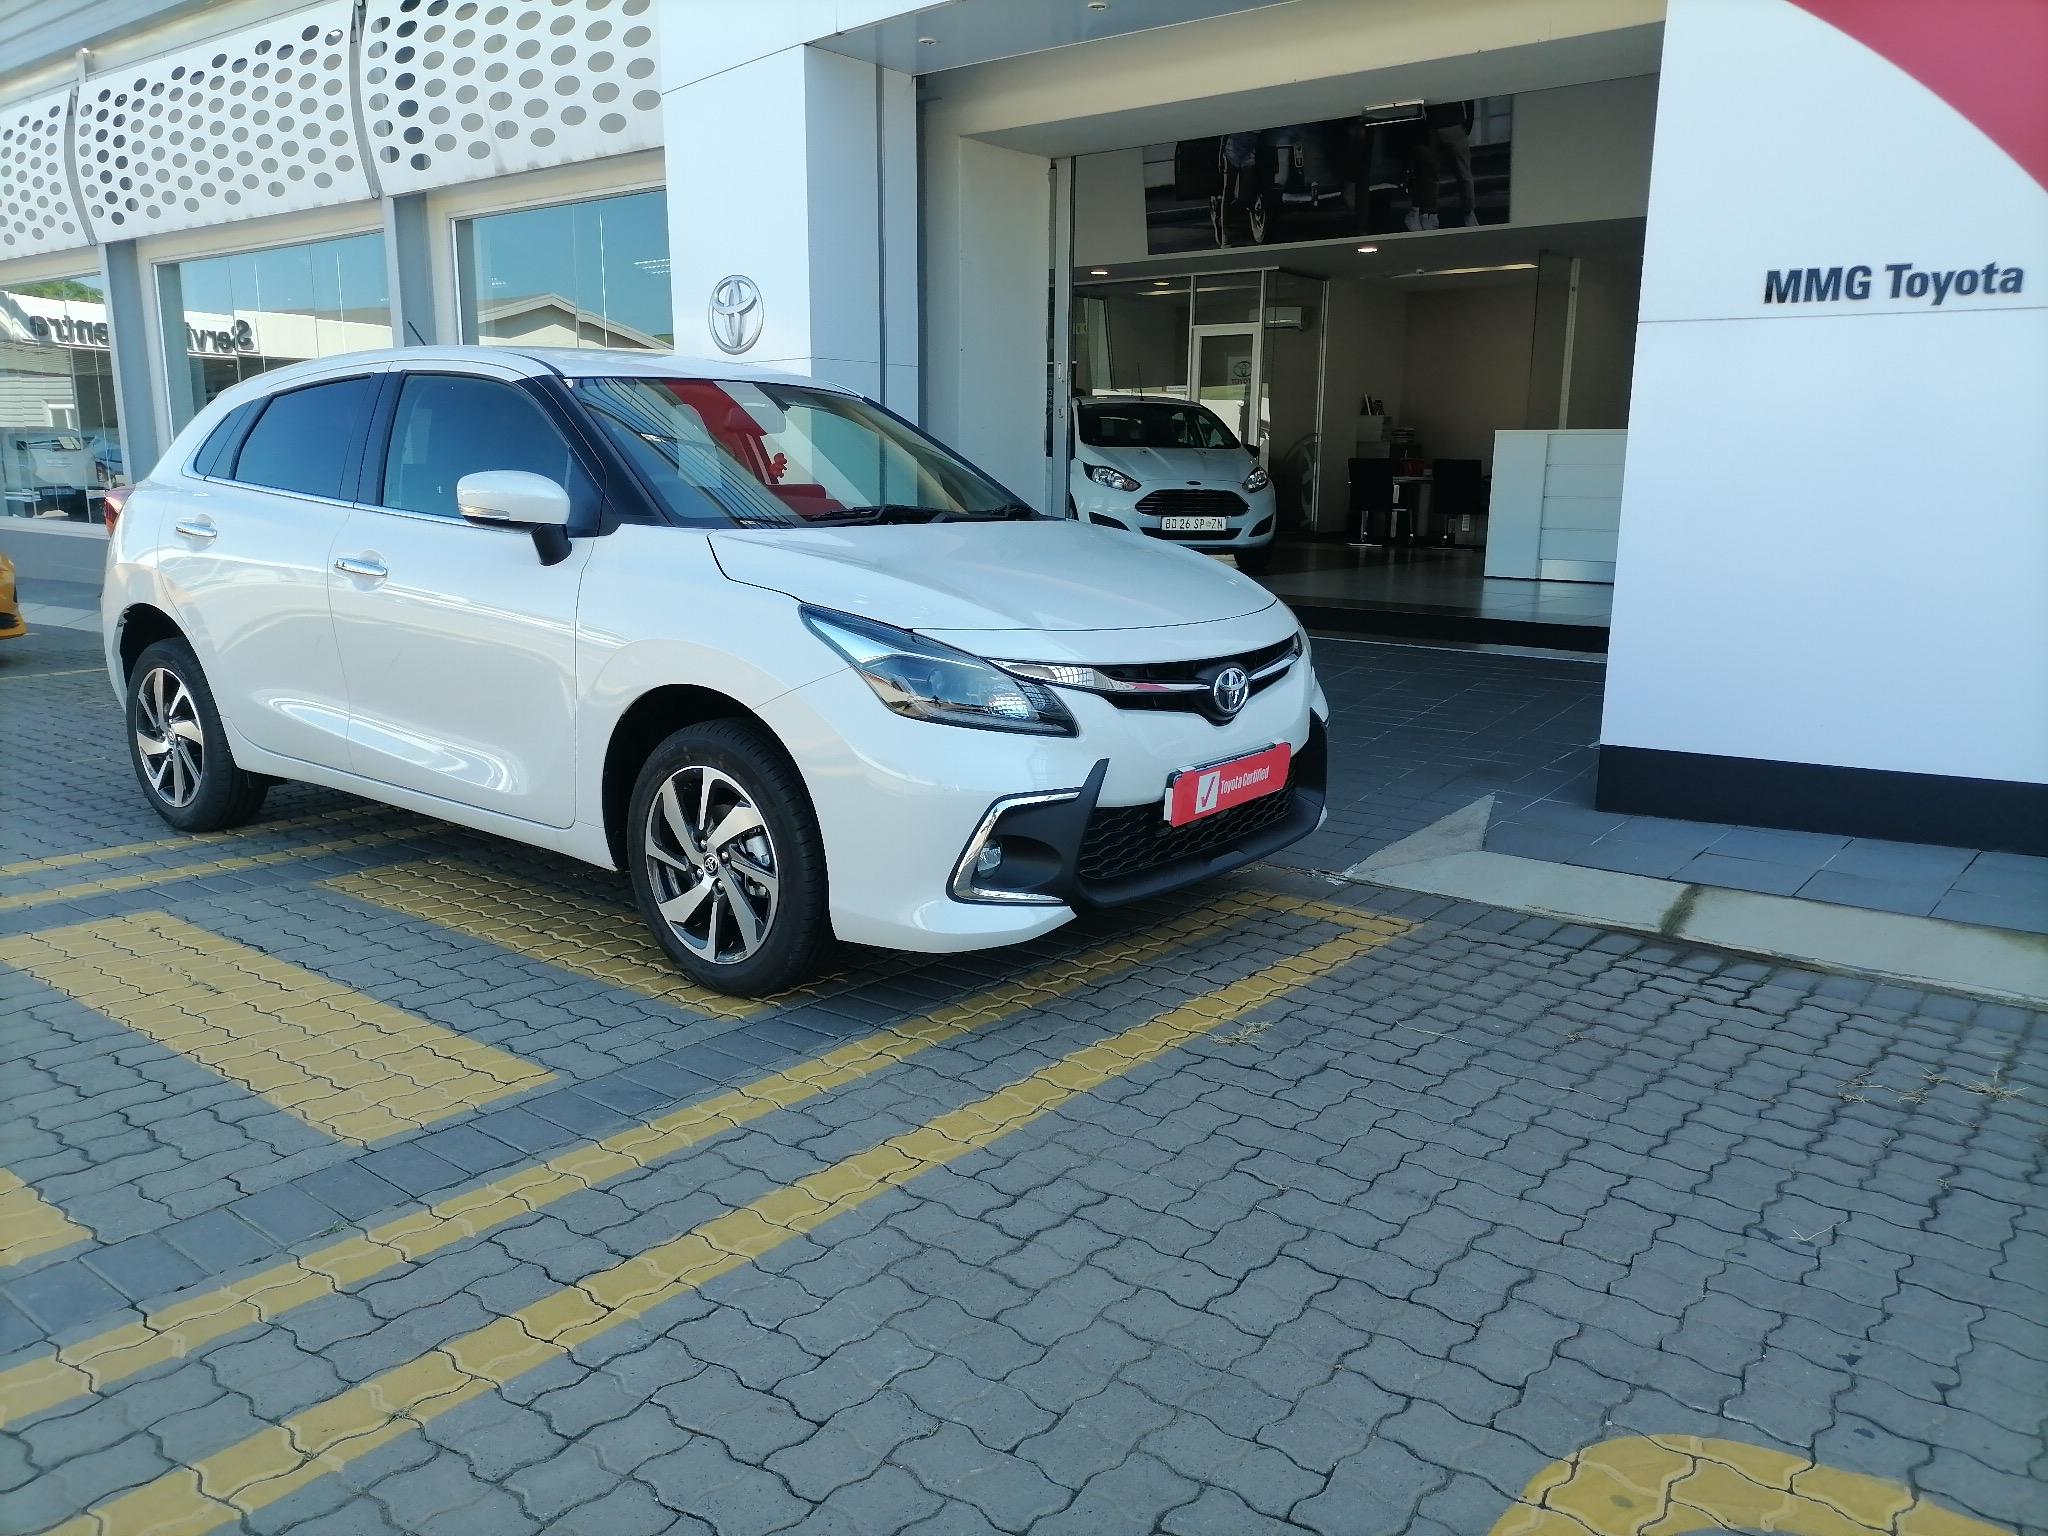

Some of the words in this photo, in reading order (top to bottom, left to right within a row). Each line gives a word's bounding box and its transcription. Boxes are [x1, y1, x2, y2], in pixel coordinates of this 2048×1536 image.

[1764, 265, 1872, 304] MMG
[1885, 261, 2024, 306] Toyota
[1165, 518, 1177, 529] BD
[1179, 518, 1191, 529] 26
[1193, 518, 1205, 529] SP
[1221, 776, 1242, 794] Toyota
[1242, 765, 1269, 786] Certified
